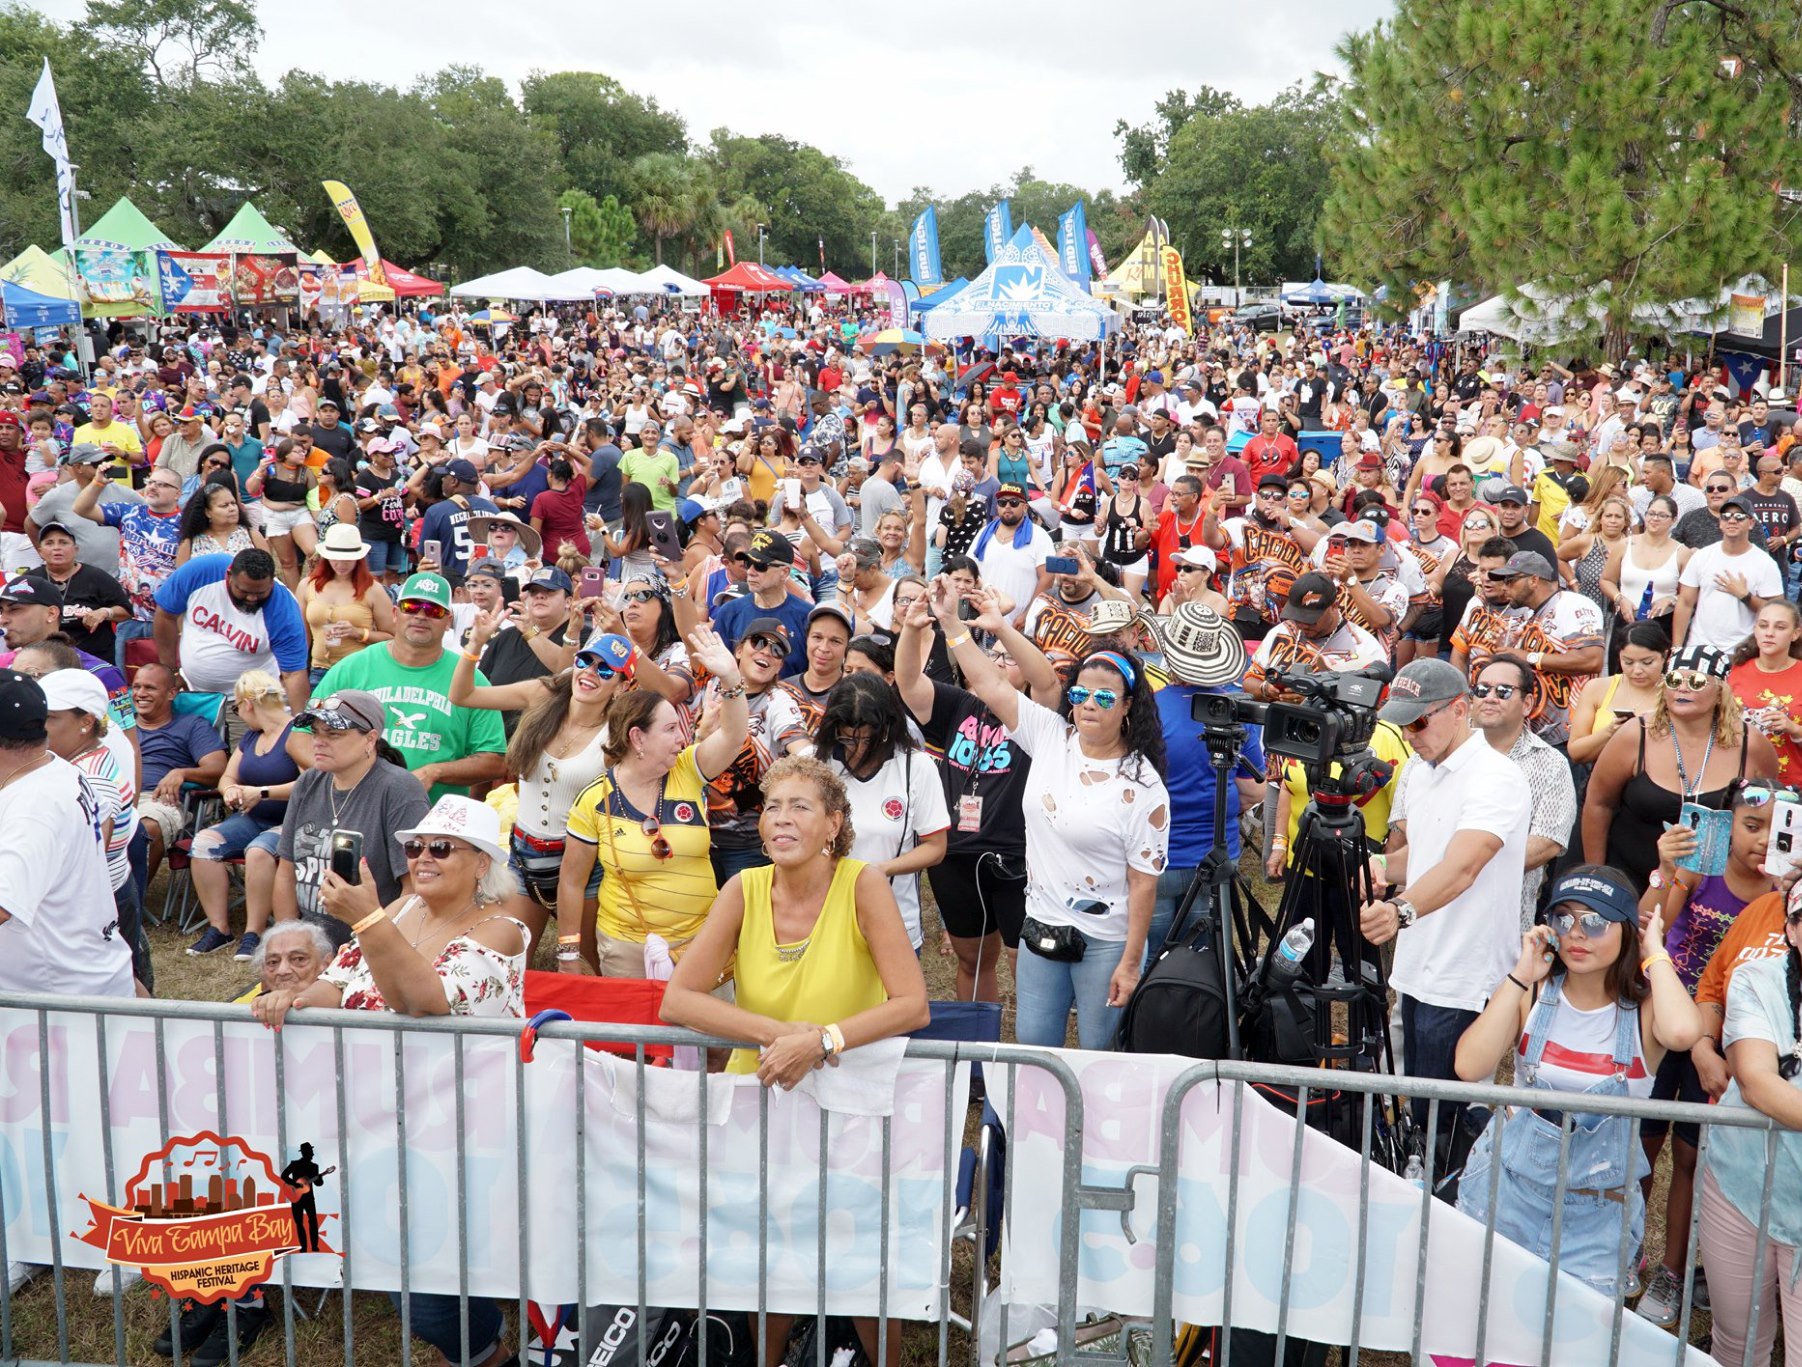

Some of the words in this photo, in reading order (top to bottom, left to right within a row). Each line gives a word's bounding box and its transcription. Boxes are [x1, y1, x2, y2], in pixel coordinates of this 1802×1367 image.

[1143, 230, 1156, 280] ATM
[453, 525, 475, 560] 5
[192, 606, 260, 654] CALVIN
[1398, 676, 1421, 698] BEACH
[380, 728, 441, 751] AGLES
